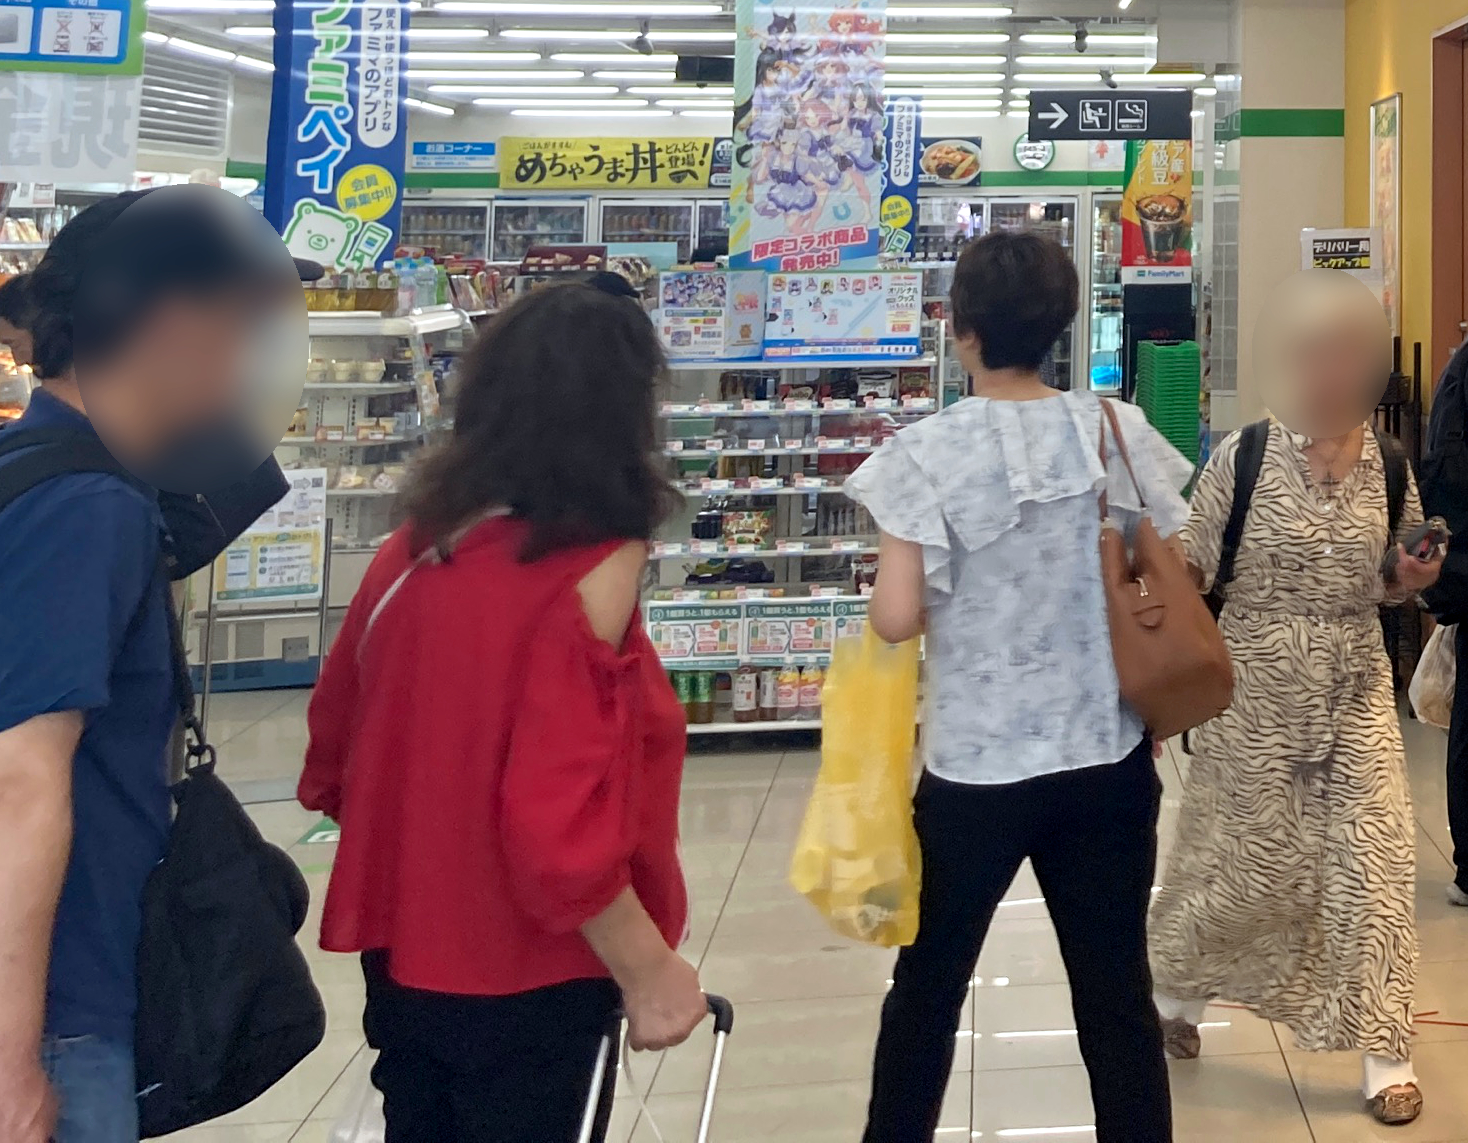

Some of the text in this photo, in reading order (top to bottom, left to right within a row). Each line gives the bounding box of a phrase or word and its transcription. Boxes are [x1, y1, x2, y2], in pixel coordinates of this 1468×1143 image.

[665, 142, 700, 154] どんどん
[515, 141, 665, 184] めちゃうま丼
[351, 174, 379, 192] 会員
[753, 226, 868, 261] 限定コラボ商品
[781, 251, 839, 271] 発売中!
[1313, 257, 1370, 268] ピックアップ
[1148, 270, 1185, 278] FamilyMart
